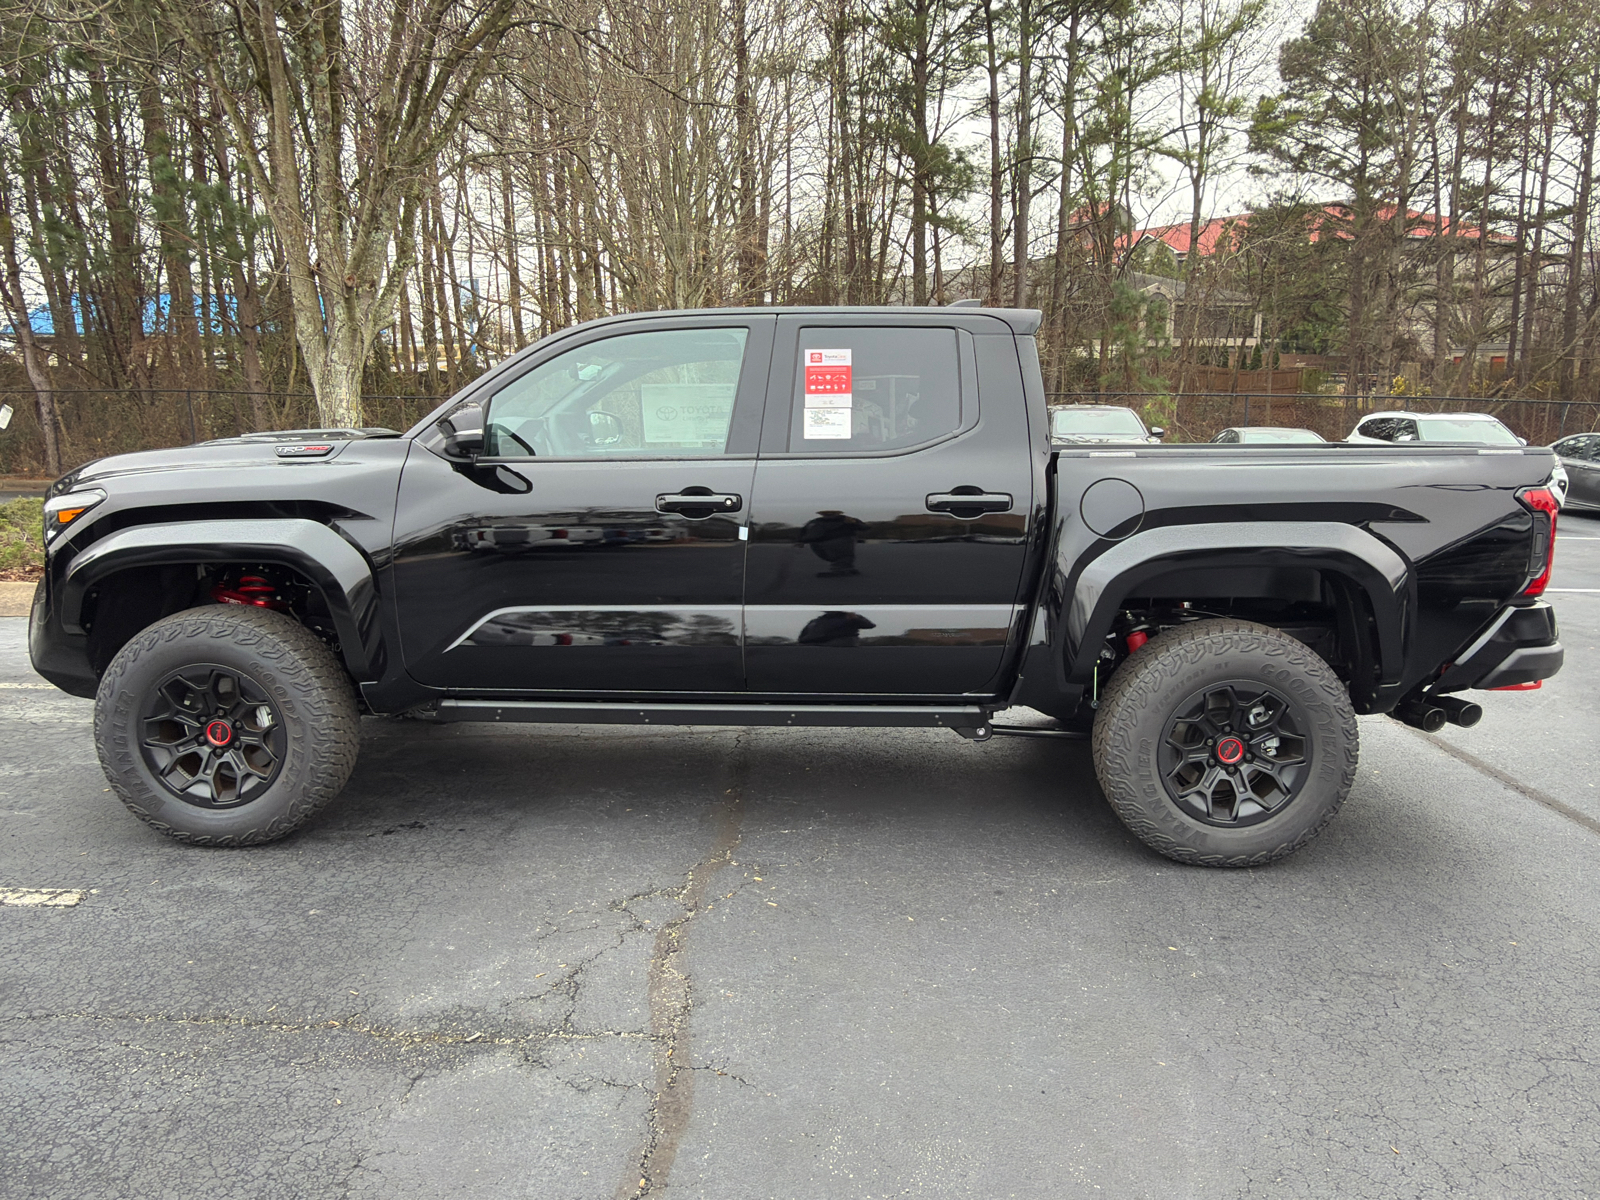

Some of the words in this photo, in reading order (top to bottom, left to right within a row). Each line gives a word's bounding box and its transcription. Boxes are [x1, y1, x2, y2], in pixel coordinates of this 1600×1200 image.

[680, 405, 723, 414] TOYOTA
[277, 446, 305, 454] TRD
[112, 689, 166, 813] WRANGLER
[1137, 737, 1209, 844] WRANGLER
